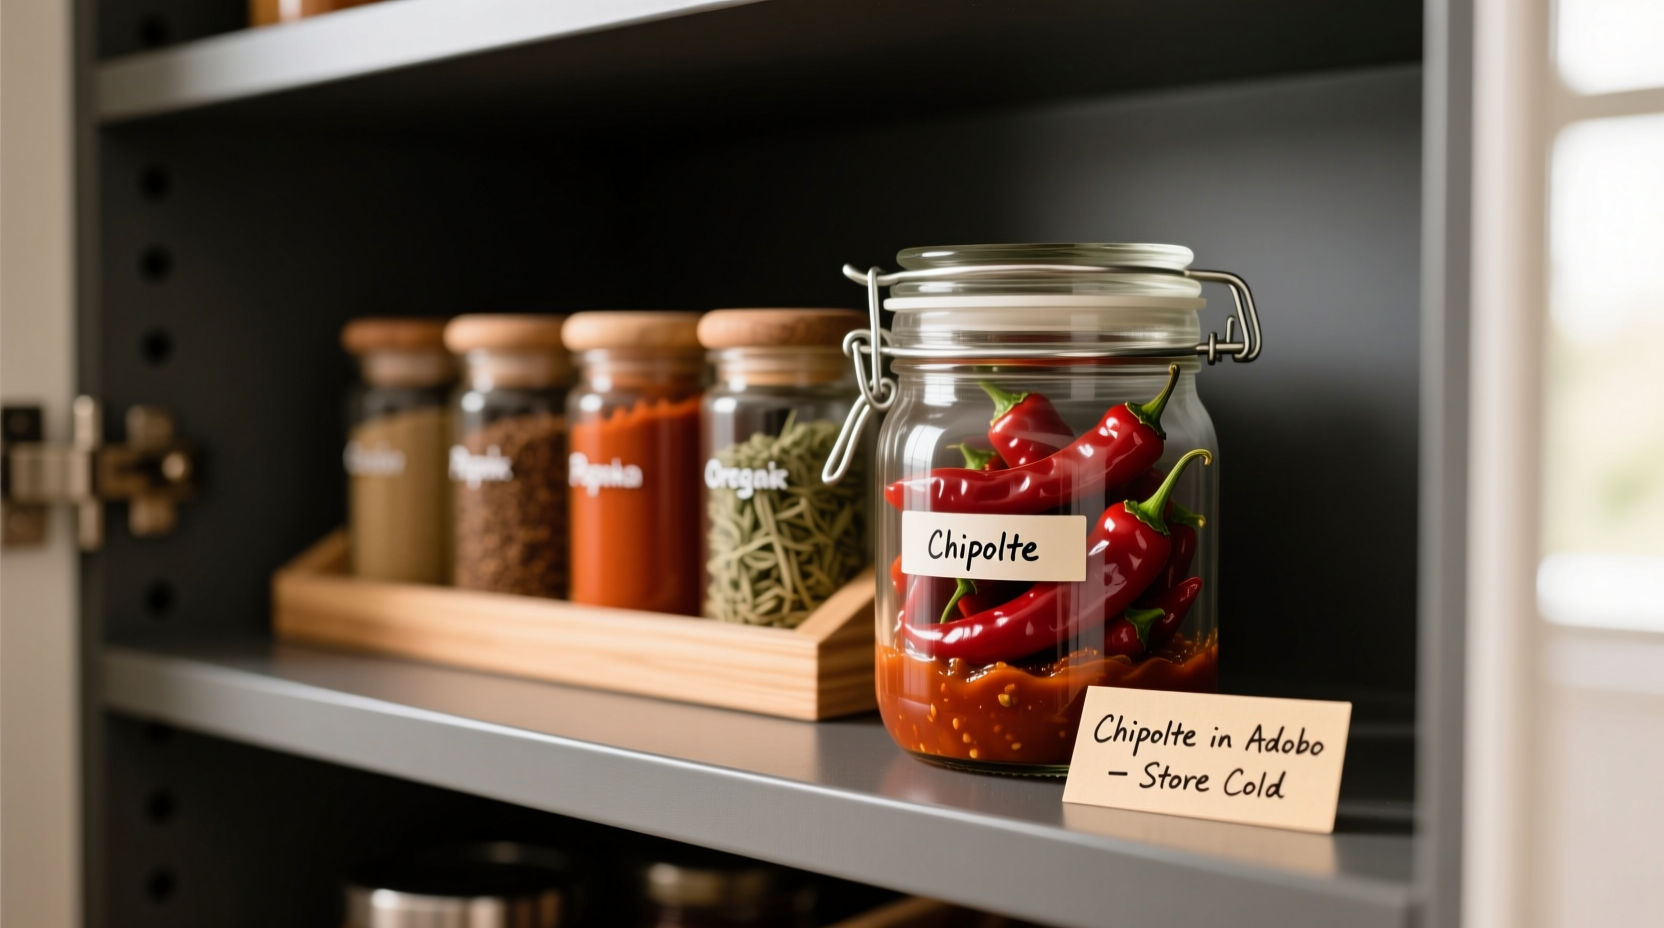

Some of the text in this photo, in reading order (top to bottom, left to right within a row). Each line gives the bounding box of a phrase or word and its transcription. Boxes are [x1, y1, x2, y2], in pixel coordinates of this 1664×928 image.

[928, 529, 1039, 571] Chipolte
[1094, 714, 1324, 757] Chipolte in Adobo
[1139, 762, 1209, 792] Store
[1223, 768, 1286, 799] Cold
